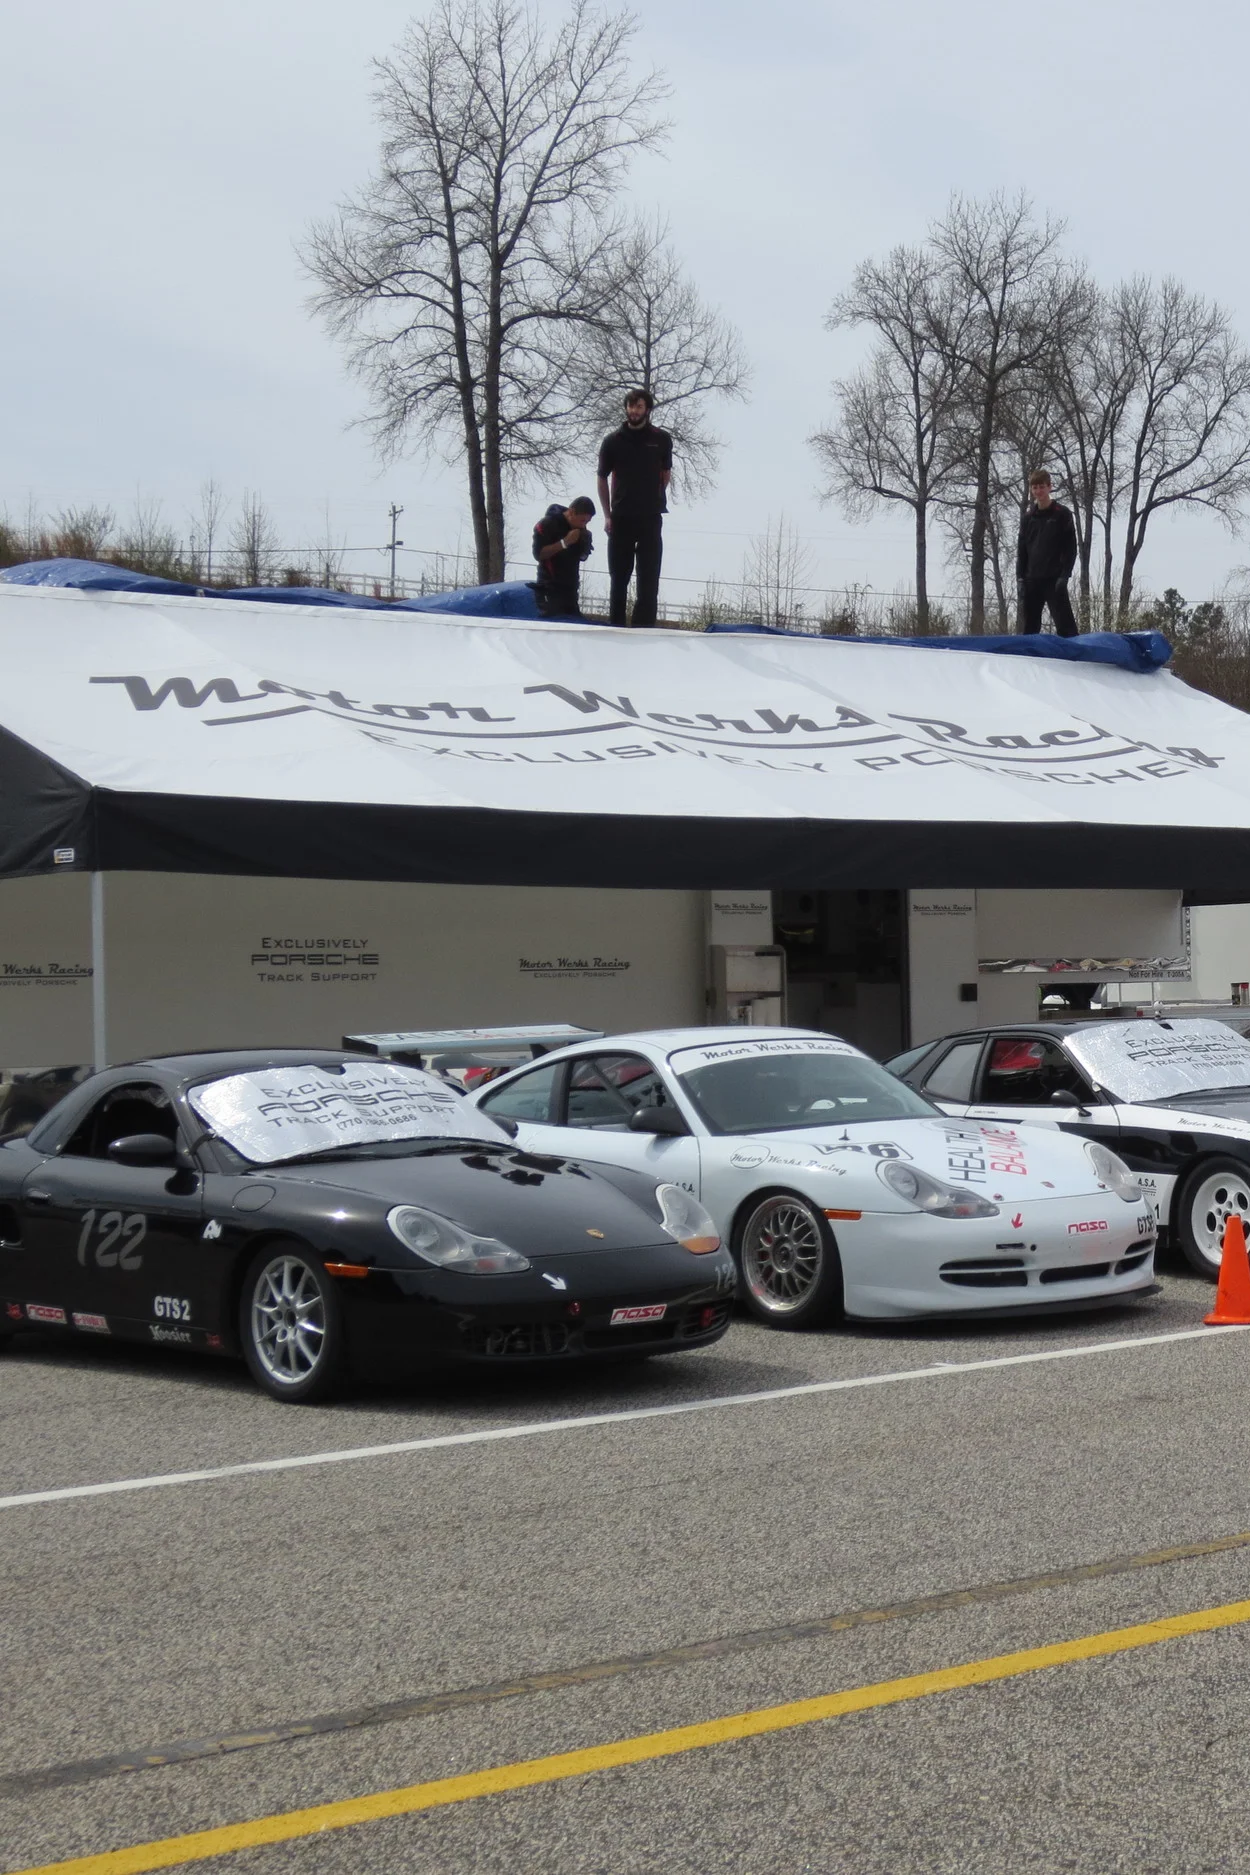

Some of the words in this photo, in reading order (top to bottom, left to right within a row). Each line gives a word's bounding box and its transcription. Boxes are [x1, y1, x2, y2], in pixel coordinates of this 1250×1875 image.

[88, 675, 516, 722] Motor
[523, 683, 892, 734] Werks
[887, 712, 1226, 769] Racing
[355, 729, 828, 773] EXCLUSIVELY
[854, 749, 1188, 785] PORSCHE
[261, 937, 369, 949] EXCLUSIVELY
[251, 953, 380, 966] PORSCHE
[518, 958, 553, 969] Motor
[556, 957, 590, 968] Werks
[592, 957, 632, 971] Racing
[47, 963, 95, 977] Racing
[257, 972, 304, 982] TRACK
[310, 972, 378, 981] SUPPORT
[700, 1047, 751, 1060] Motor
[752, 1043, 803, 1052] Werks
[802, 1041, 854, 1054] Racing
[261, 1076, 427, 1099] EXCLUSIVELY
[257, 1089, 456, 1117] PORSCHE
[266, 1108, 349, 1128] TRACK
[357, 1104, 455, 1118] SUPPORT
[731, 1153, 763, 1163] Motor
[1067, 1221, 1108, 1234] nasa
[77, 1209, 147, 1270] 122
[612, 1306, 665, 1322] nasa
[149, 1325, 192, 1343] Hoosier
